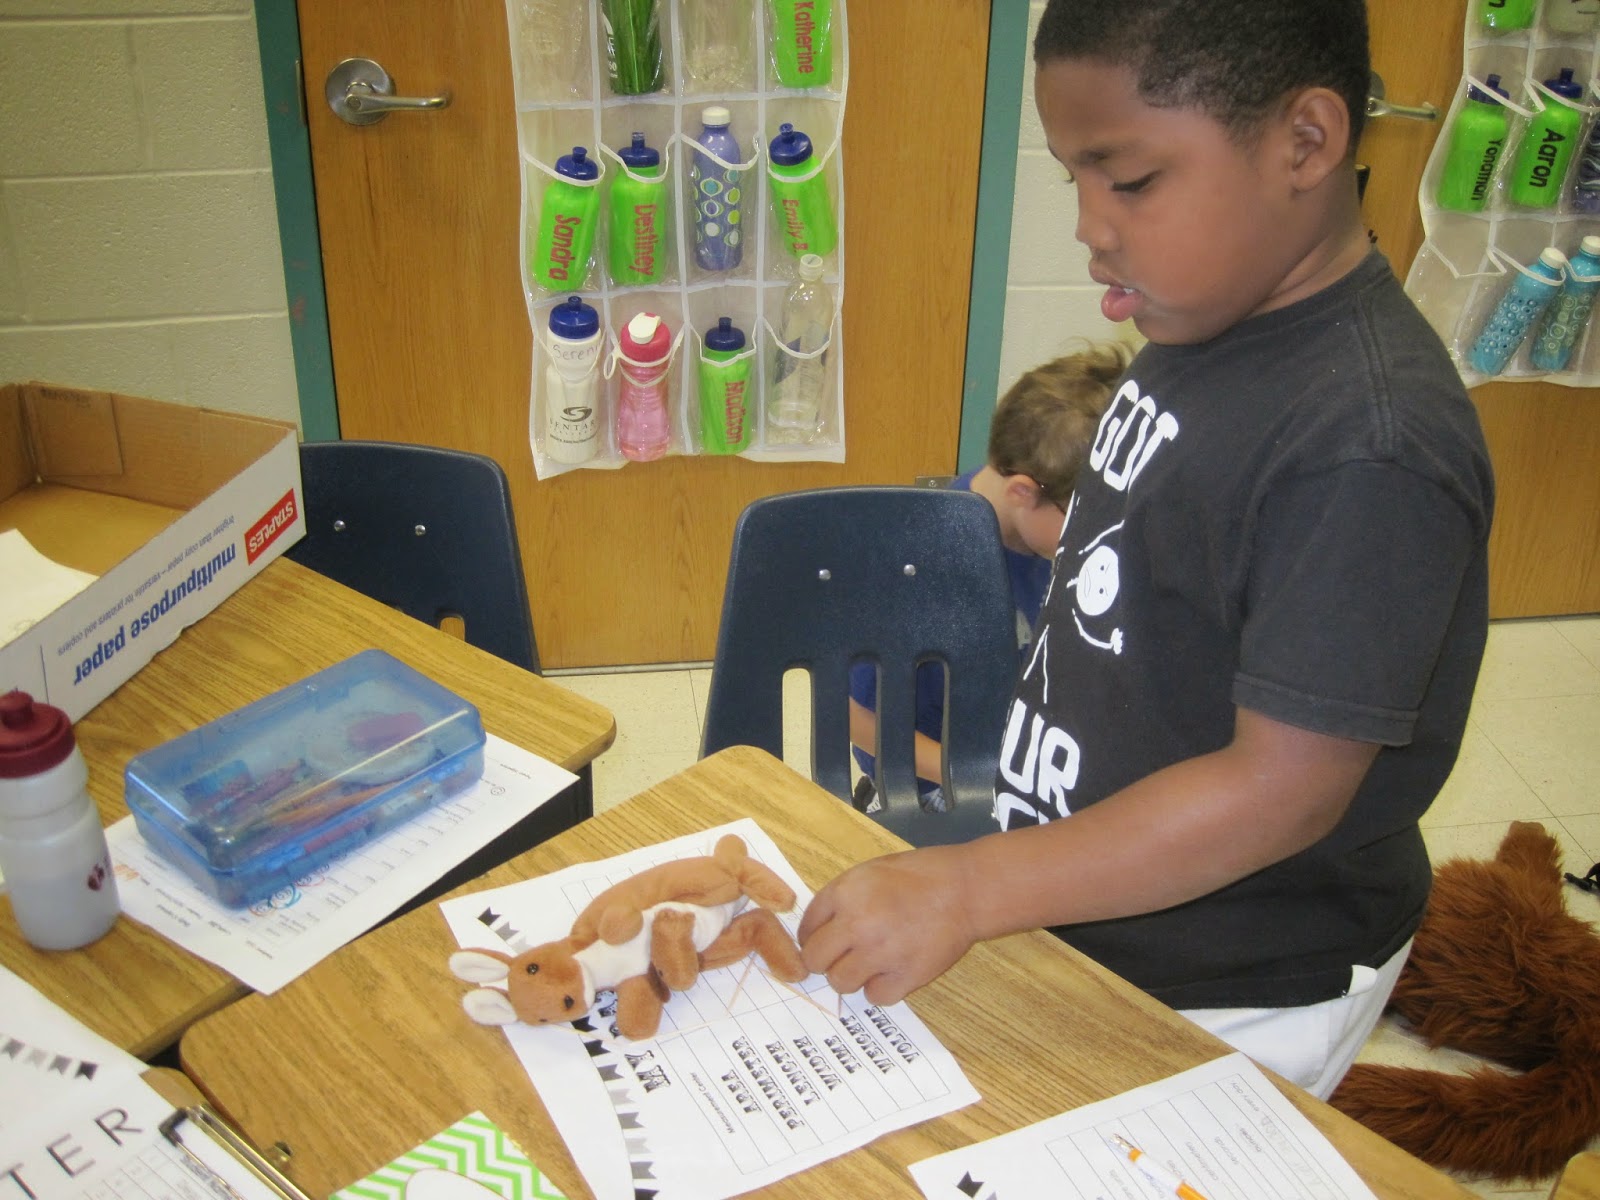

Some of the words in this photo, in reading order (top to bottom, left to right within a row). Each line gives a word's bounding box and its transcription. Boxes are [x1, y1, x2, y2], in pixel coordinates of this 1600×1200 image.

[794, 1, 817, 74] Katherine
[1529, 127, 1566, 188] Aaron
[629, 204, 656, 277] Destiney
[782, 199, 804, 240] Emily
[548, 214, 581, 281] Sandra
[725, 380, 746, 445] Madison
[1089, 379, 1179, 492] GOT
[184, 543, 199, 557] copy
[212, 515, 235, 536] brighter
[249, 501, 294, 553] STAPLES
[134, 572, 161, 597] versatile
[167, 553, 184, 572] paper
[98, 598, 124, 625] printers
[131, 543, 236, 639] multipurpose
[57, 632, 84, 657] copiers
[73, 625, 126, 686] paper
[84, 622, 97, 639] and
[823, 1035, 863, 1074] TIME
[839, 1015, 897, 1074] WEIGHT
[863, 1005, 921, 1064] VOLUME
[624, 1050, 671, 1094] MY
[690, 1072, 706, 1092] Center
[732, 1036, 805, 1130] PERIMETER
[765, 1041, 821, 1106] LENGTH
[793, 1036, 843, 1091] WIDTH
[704, 1092, 735, 1134] Measurement
[721, 1068, 762, 1113] AREA
